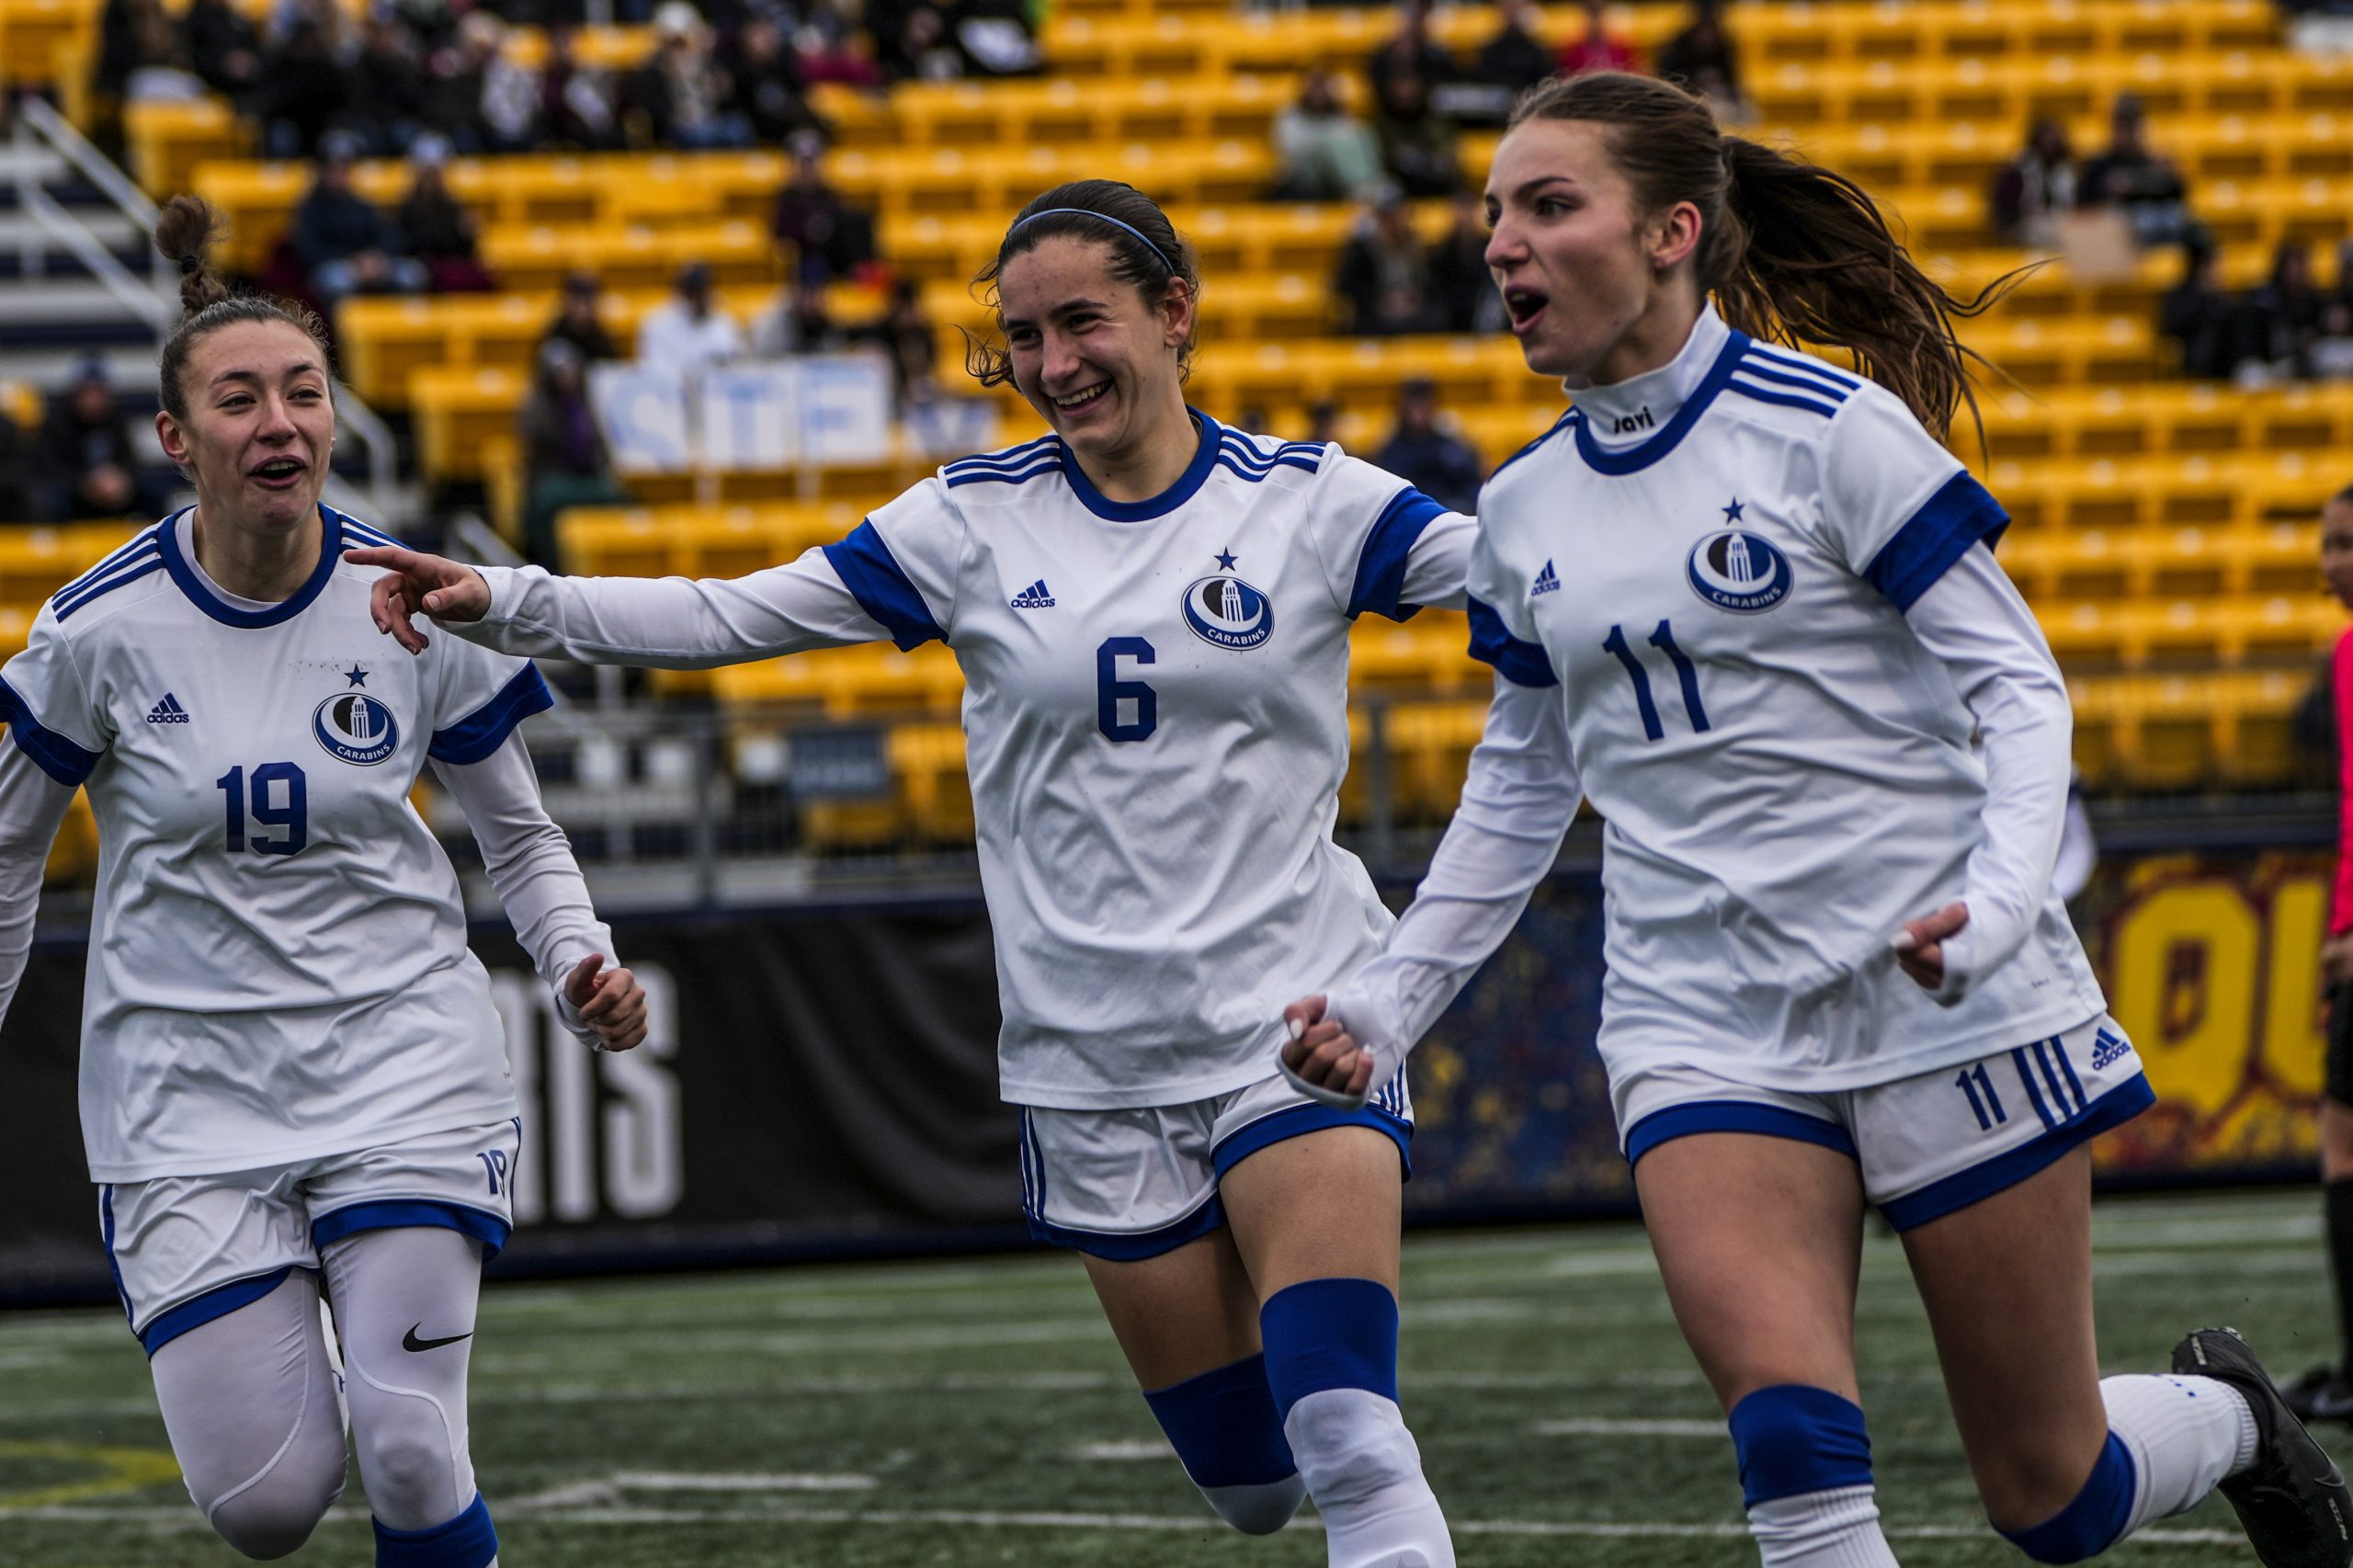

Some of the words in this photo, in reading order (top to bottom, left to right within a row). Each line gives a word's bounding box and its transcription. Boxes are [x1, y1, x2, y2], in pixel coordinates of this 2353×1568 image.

[1530, 579, 1561, 597] adidas
[1711, 586, 1782, 608] CARABINS
[1011, 596, 1056, 609] adidas
[1207, 627, 1267, 645] CARABINS
[1097, 636, 1157, 743] 6
[1602, 618, 1711, 743] 11
[146, 712, 189, 724] adidas
[336, 744, 392, 761] CARABINS
[216, 761, 308, 856] 19
[2092, 1041, 2131, 1071] adidas
[1955, 1062, 2007, 1131] 11
[475, 1149, 507, 1199] 19
